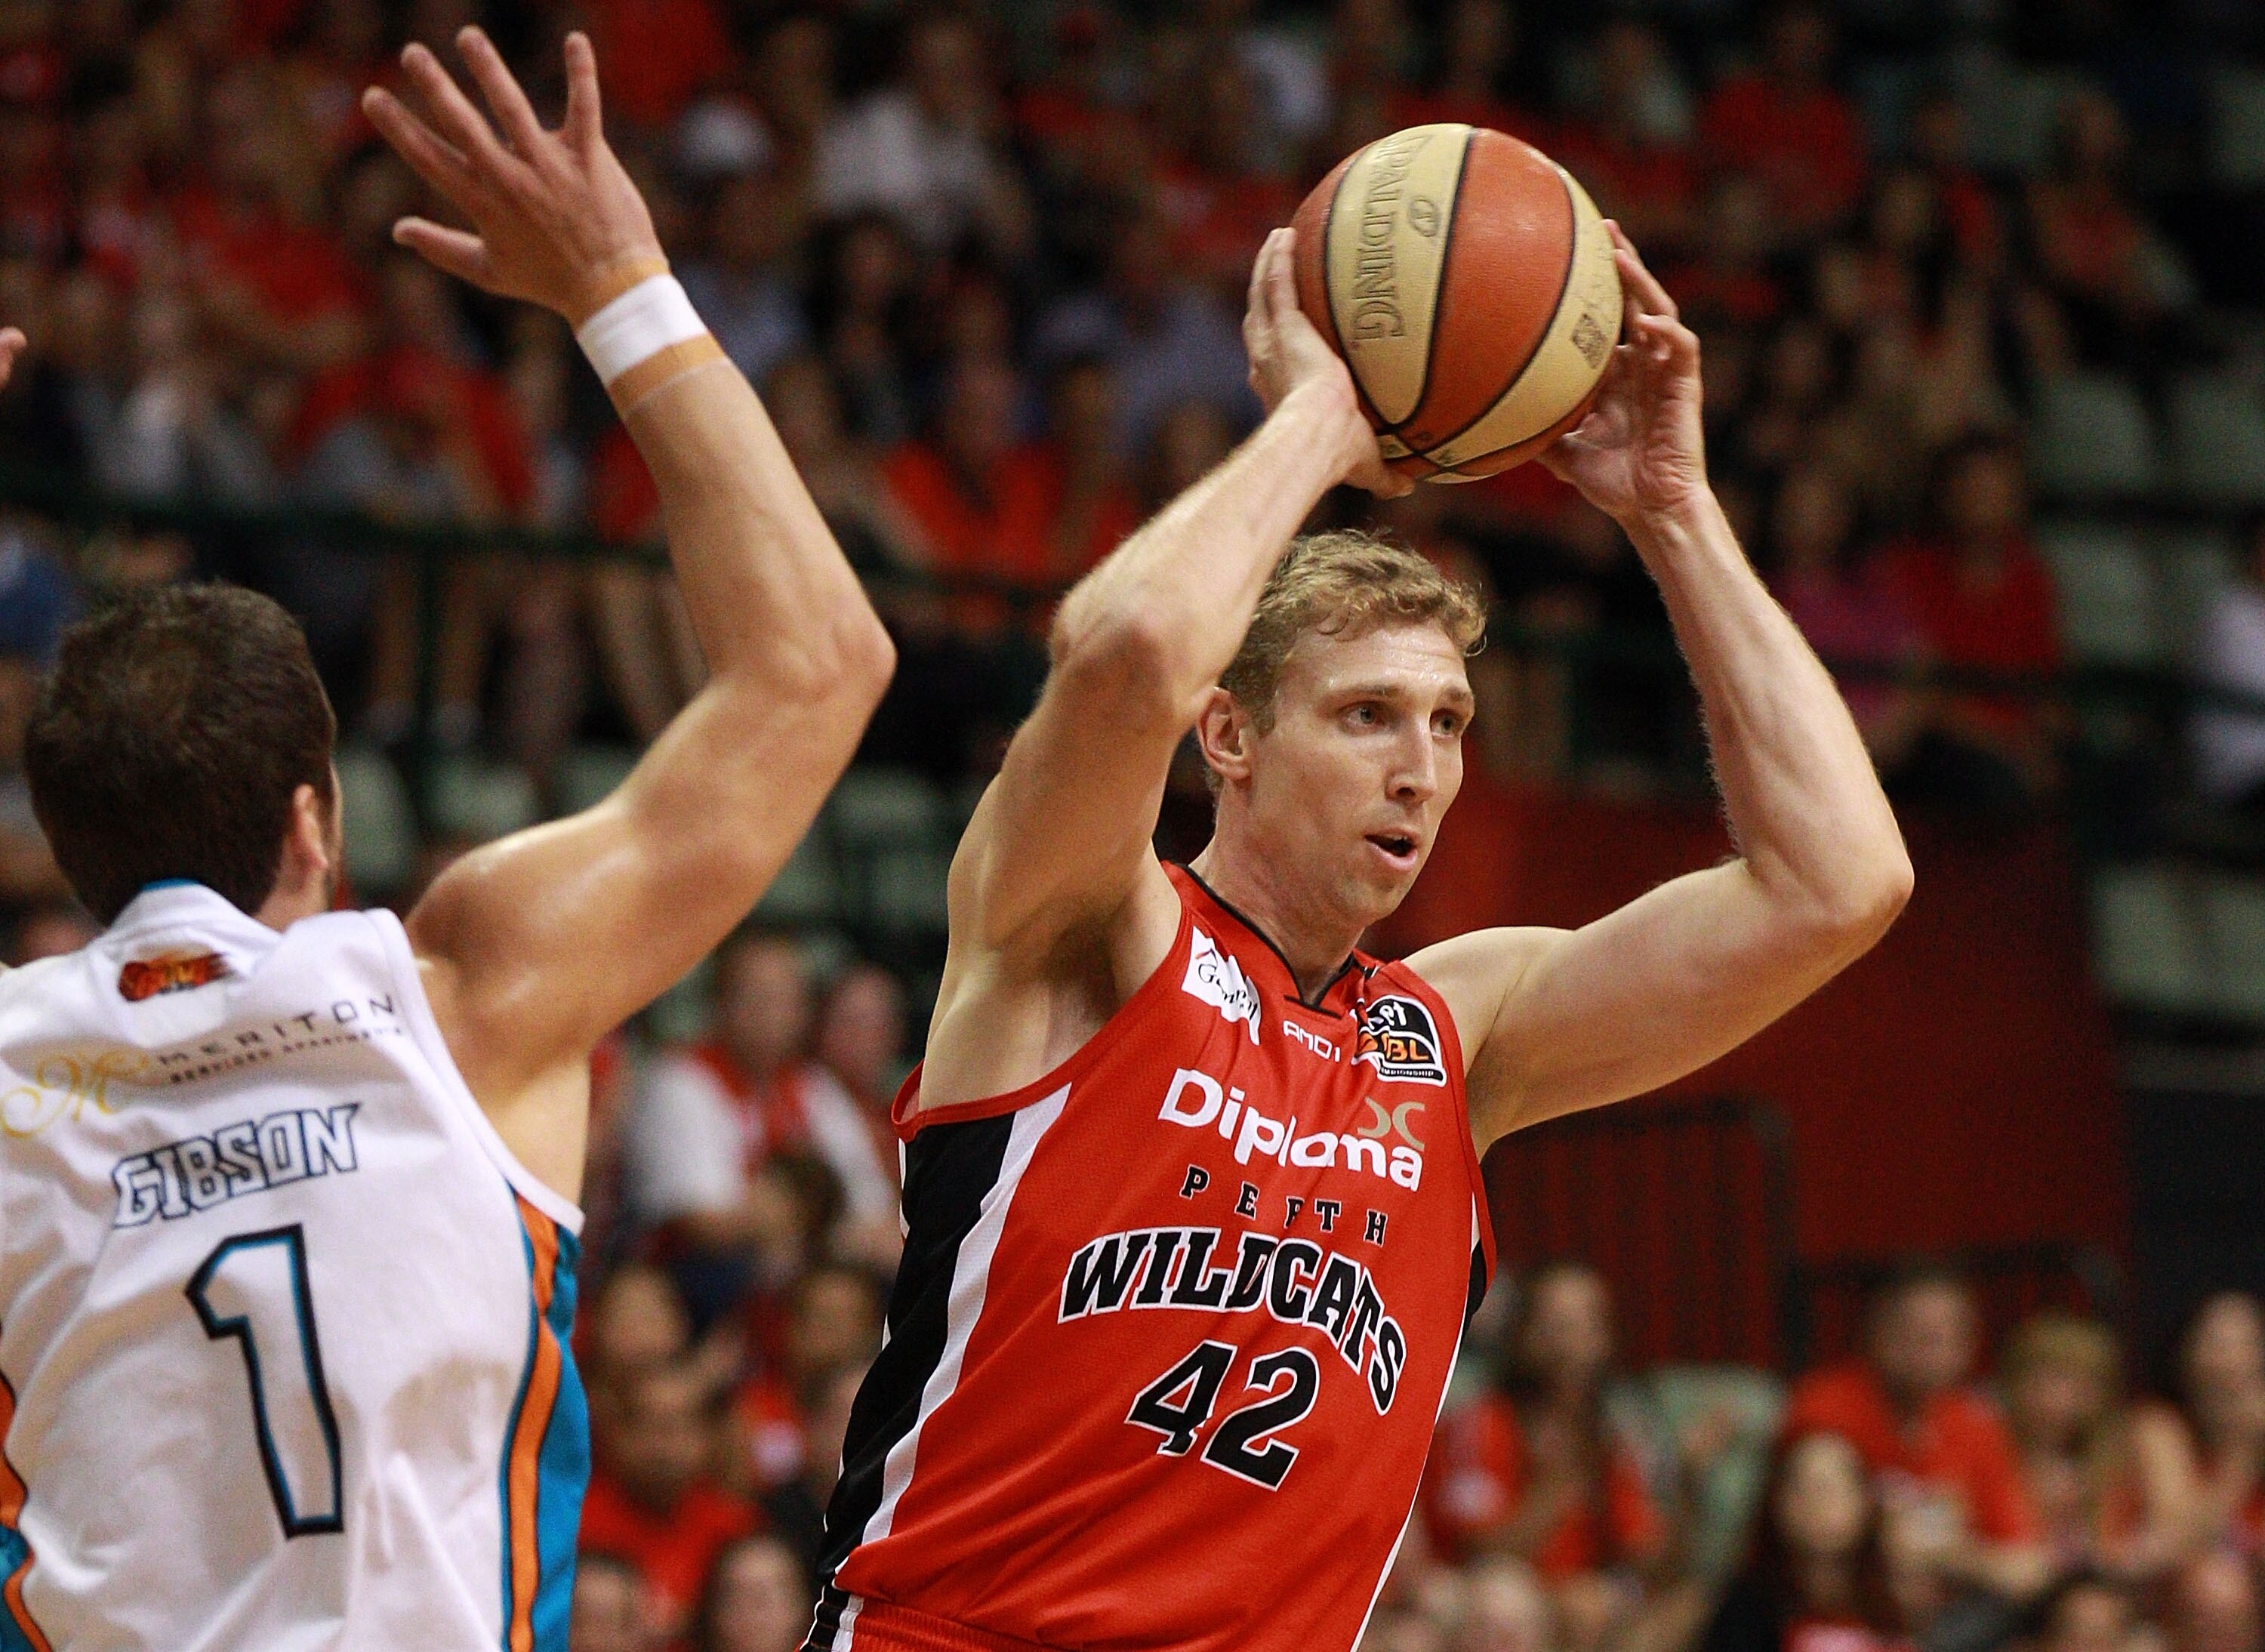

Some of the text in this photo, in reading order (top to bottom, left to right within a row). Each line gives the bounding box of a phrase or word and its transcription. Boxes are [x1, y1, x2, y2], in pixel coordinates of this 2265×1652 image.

[112, 1102, 362, 1229] GIBSON
[1157, 1068, 1424, 1192] Diploma
[184, 1222, 344, 1540] 1
[1057, 1225, 1407, 1416] WILDCATS
[1123, 1339, 1320, 1492] 42
